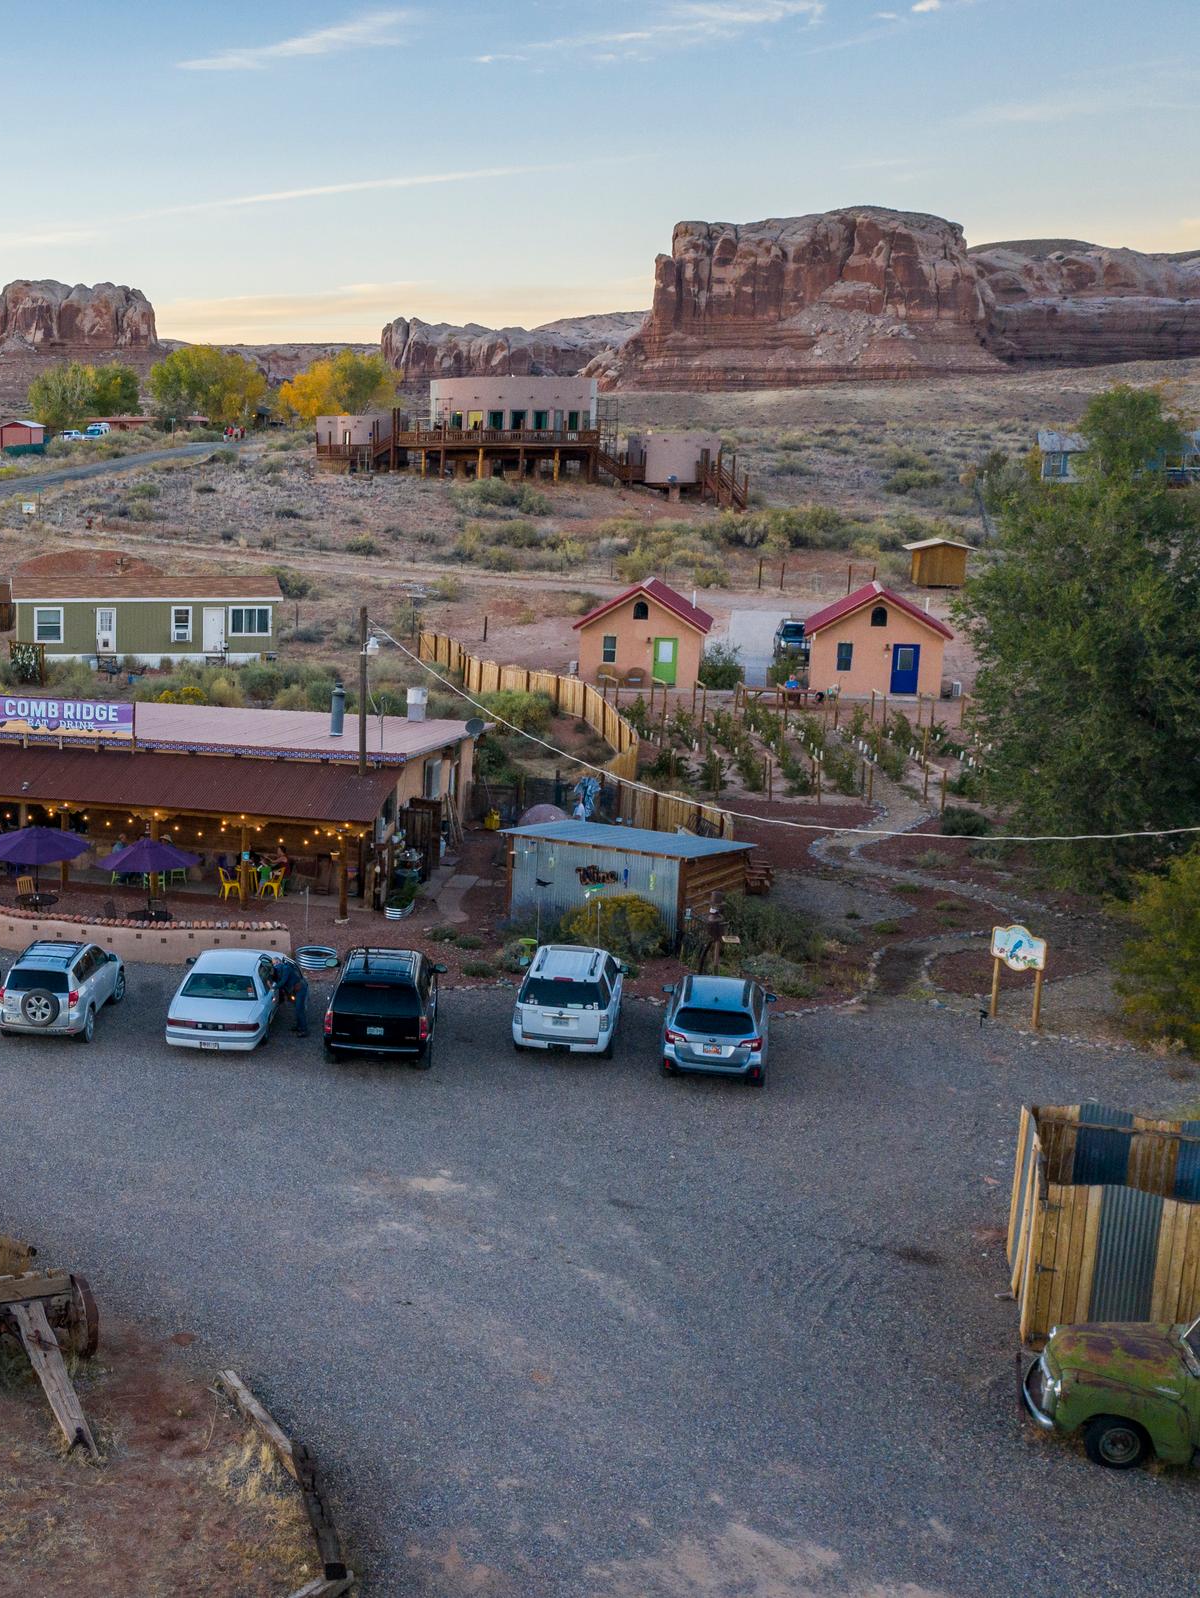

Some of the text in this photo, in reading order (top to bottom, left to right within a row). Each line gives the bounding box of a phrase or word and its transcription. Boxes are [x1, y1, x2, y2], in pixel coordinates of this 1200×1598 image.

[4, 699, 119, 722] COMB RIDGE
[27, 718, 95, 730] EAT DRINK
